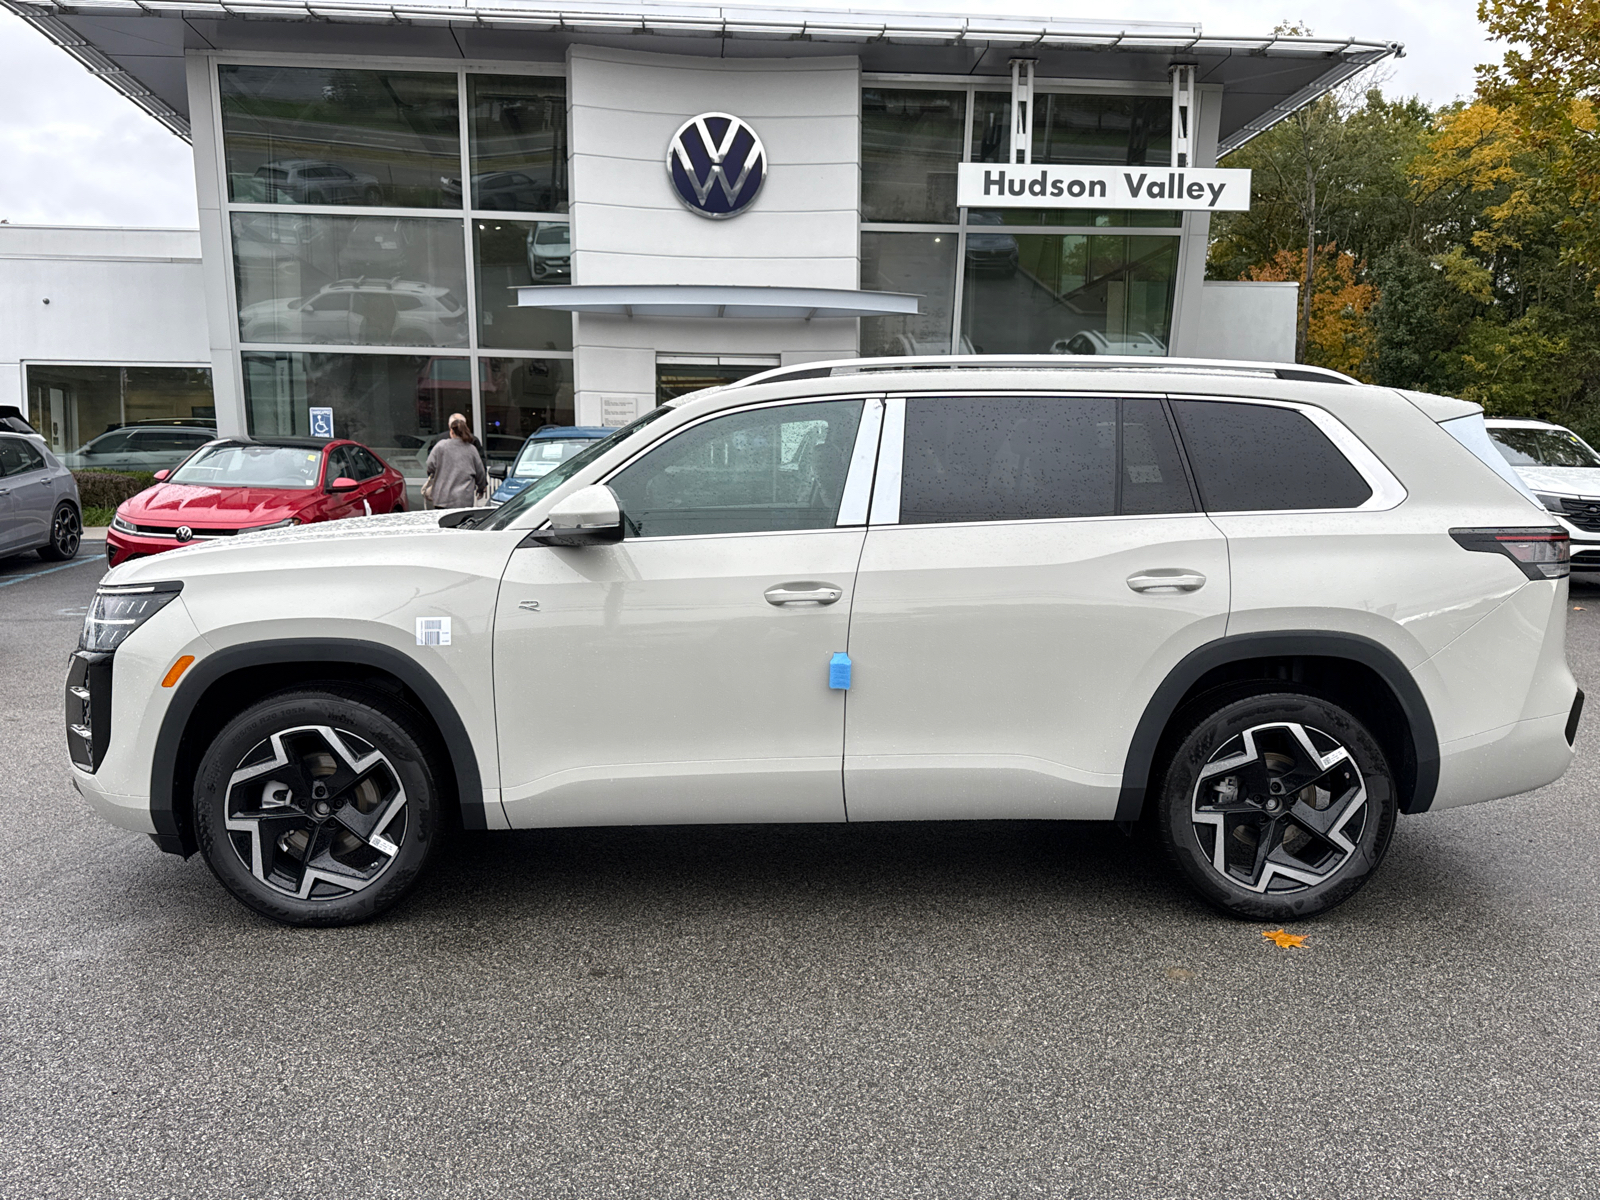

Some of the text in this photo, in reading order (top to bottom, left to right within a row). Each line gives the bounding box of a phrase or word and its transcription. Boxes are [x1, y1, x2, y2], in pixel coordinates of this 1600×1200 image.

[983, 170, 1227, 207] Hudson Valley
[259, 713, 277, 725] R20
[280, 706, 306, 716] 105H
